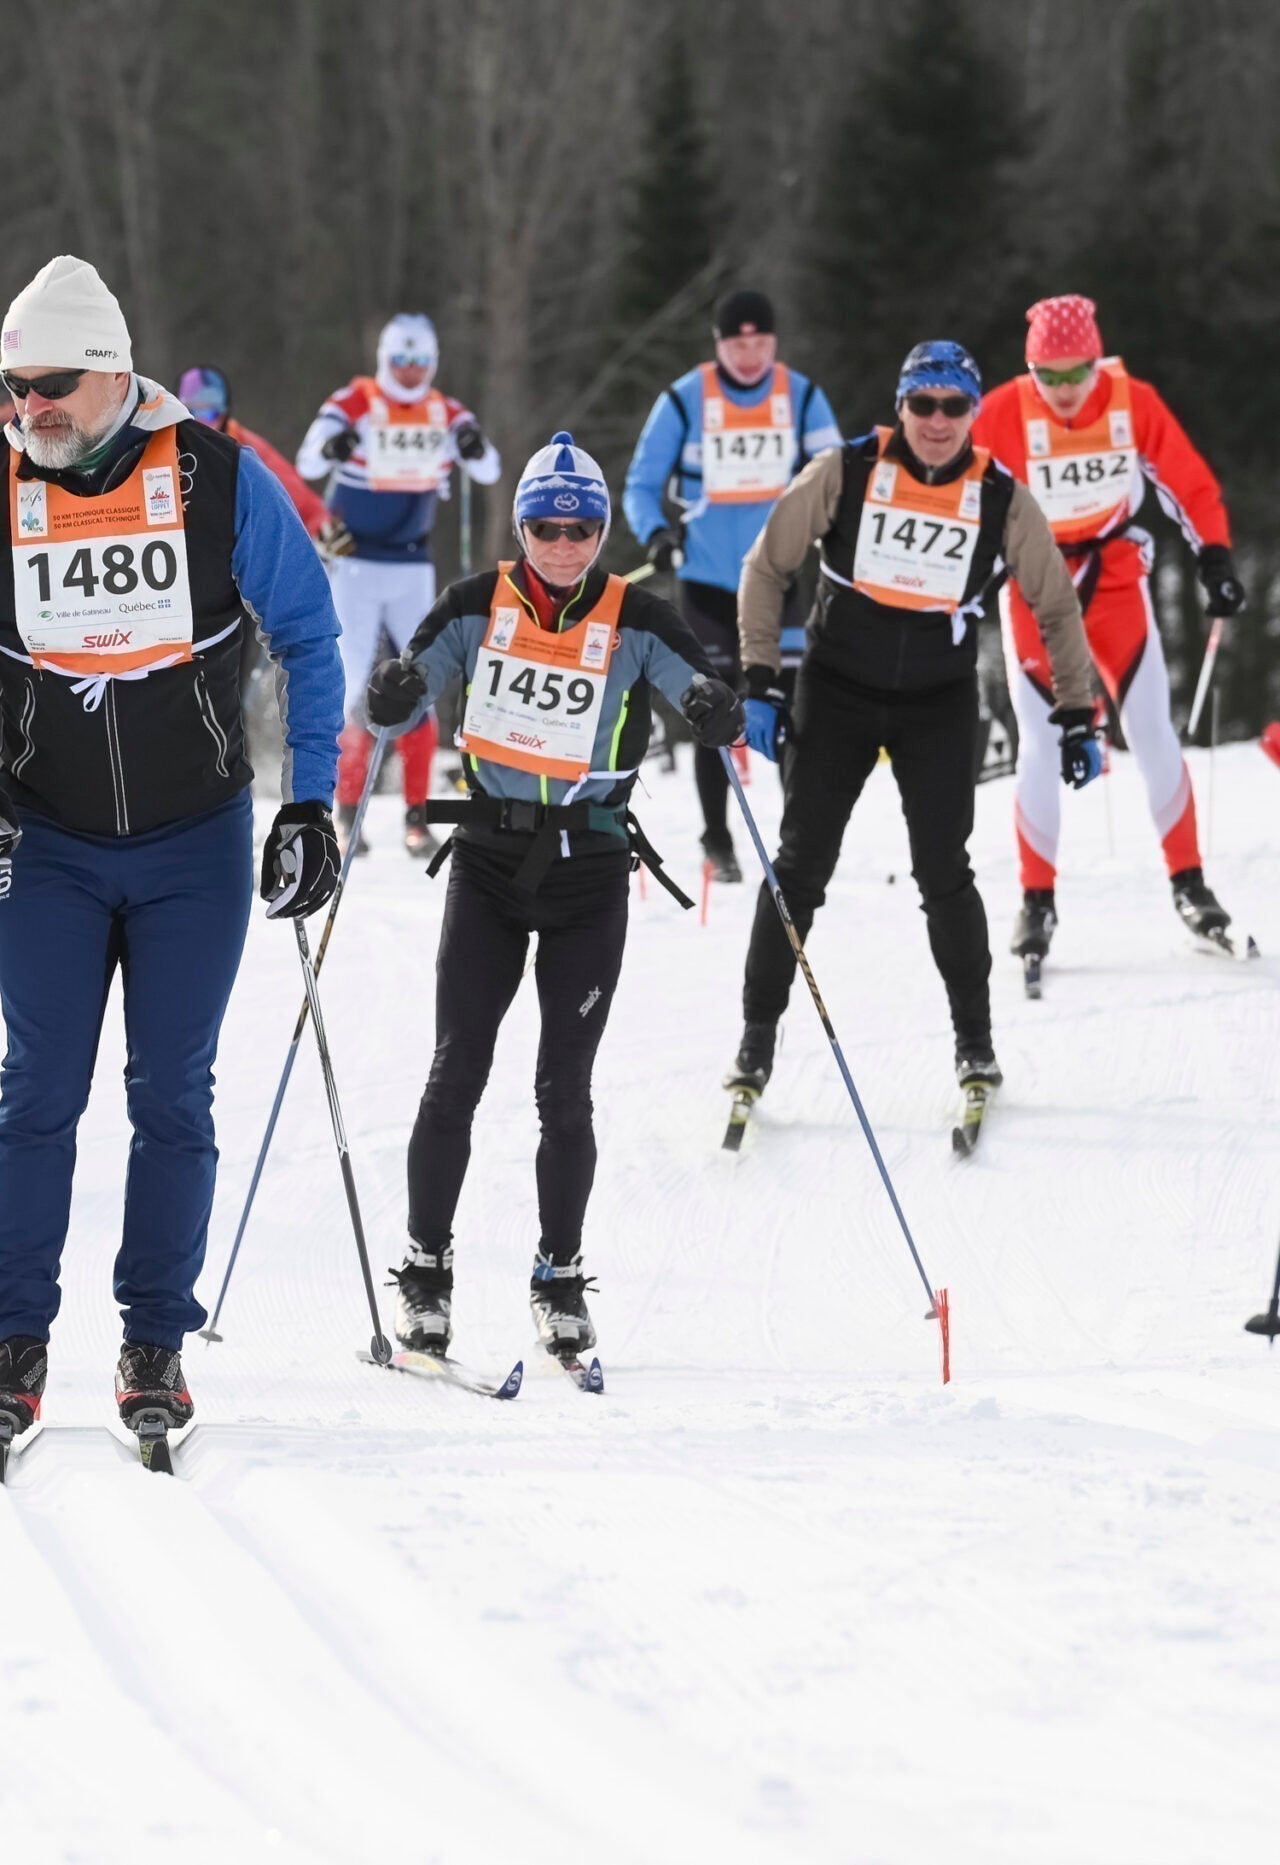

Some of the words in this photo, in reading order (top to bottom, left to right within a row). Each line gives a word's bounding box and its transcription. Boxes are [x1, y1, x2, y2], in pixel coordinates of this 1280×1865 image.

[84, 348, 112, 358] CRAFT
[378, 430, 442, 453] 1449
[712, 434, 782, 459] 1471
[1037, 455, 1128, 490] 1482
[72, 508, 105, 518] TECHNIQUE
[106, 506, 140, 514] CLASSIQUE
[73, 518, 104, 527] CLASSICAL
[105, 514, 140, 523] TECHNIQUE
[872, 512, 968, 560] 1472
[27, 540, 177, 602] 1480
[56, 610, 72, 618] Ville
[72, 609, 81, 618] de
[82, 608, 112, 616] Gatineau
[119, 602, 156, 614] Québec
[488, 659, 595, 715] 1459
